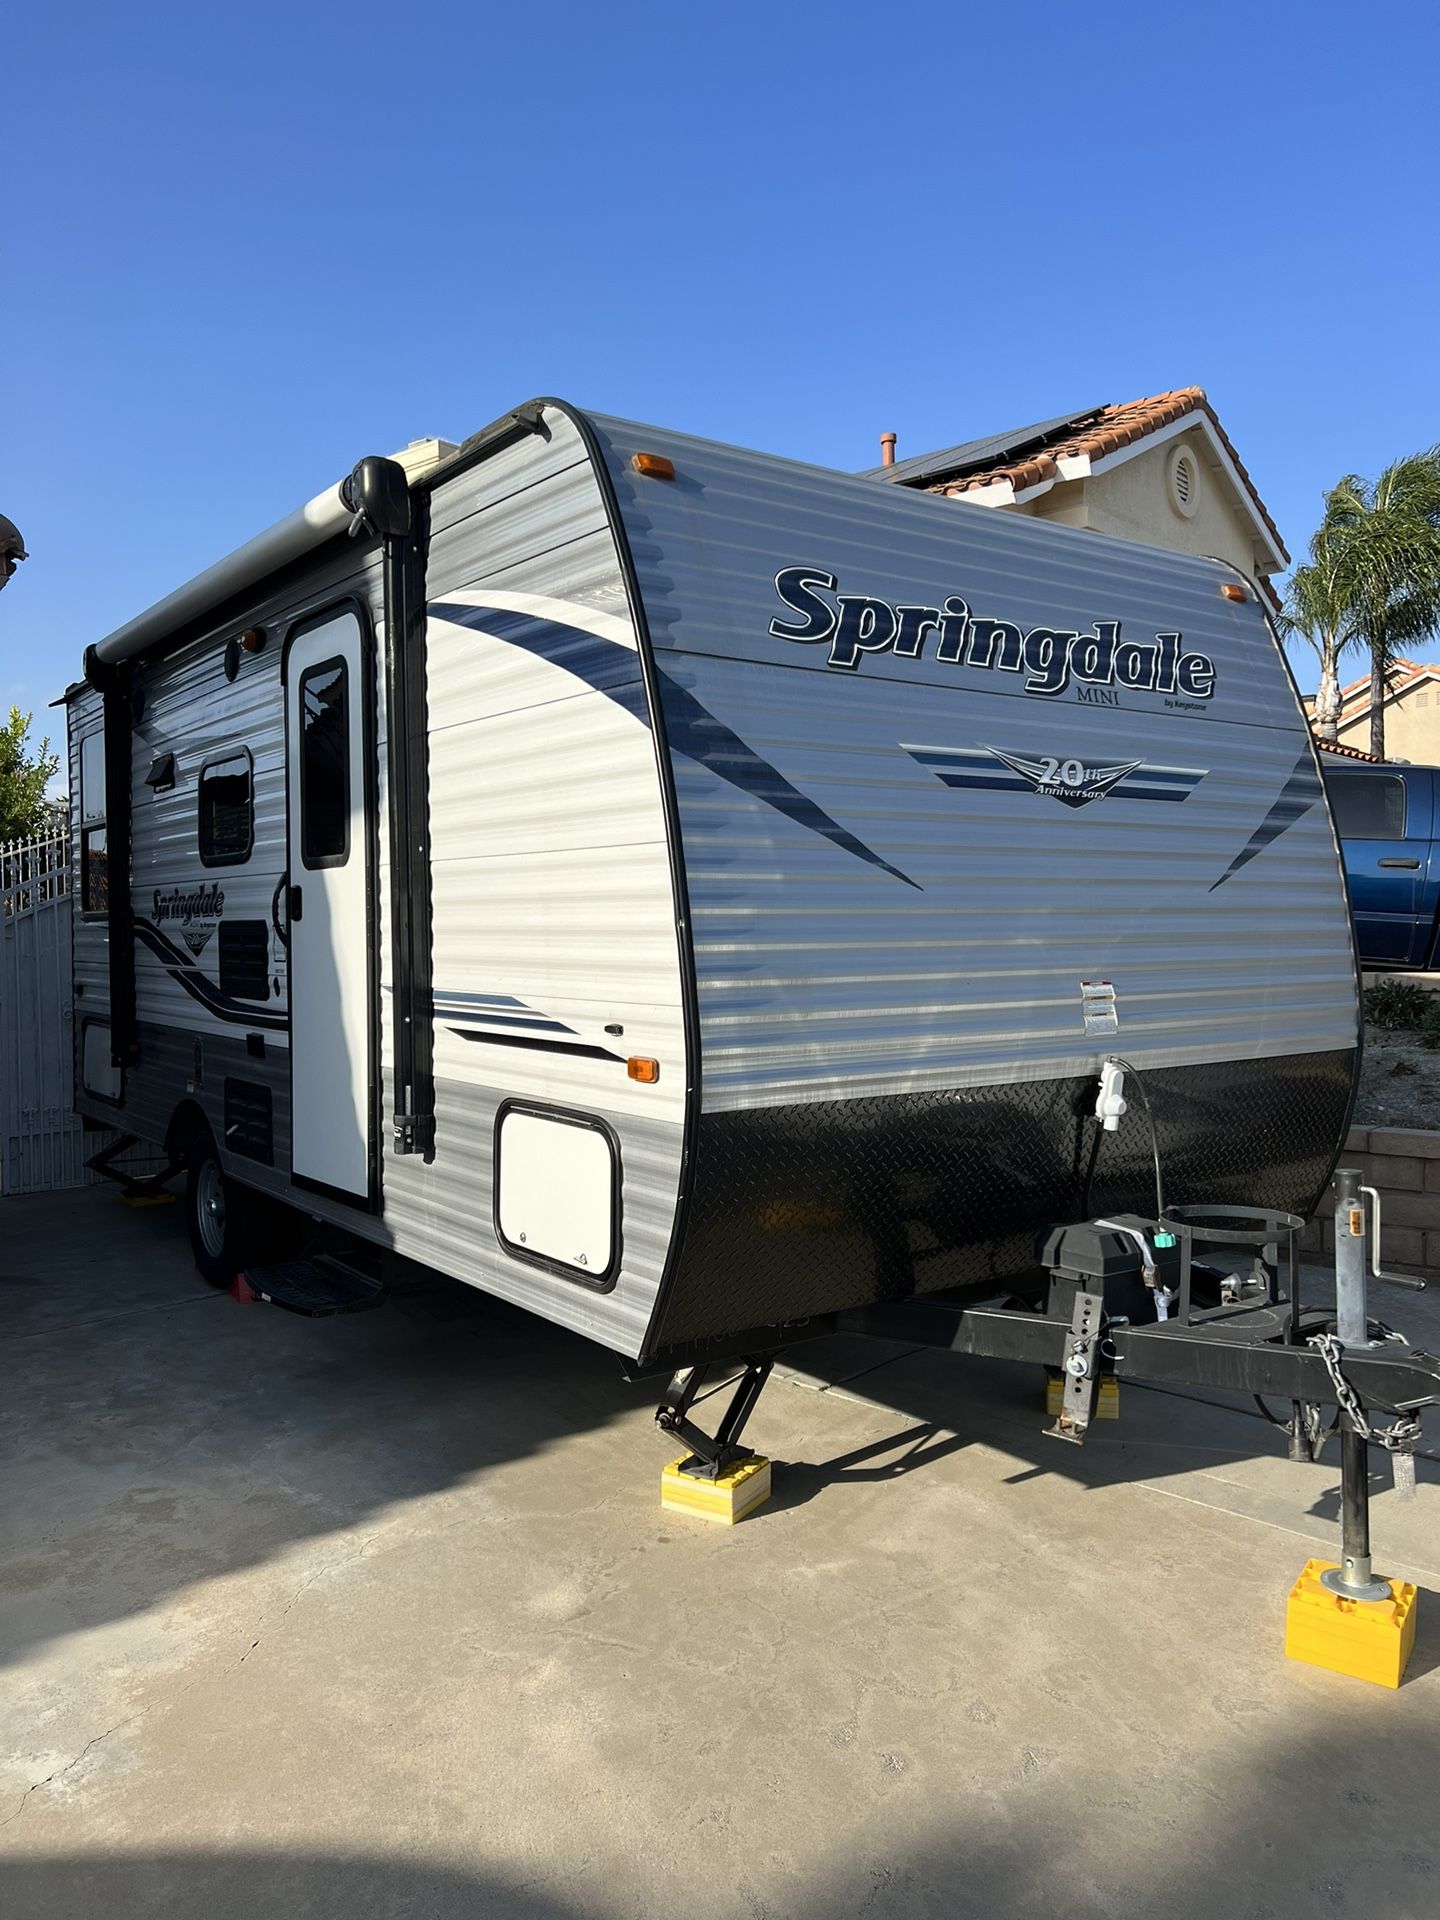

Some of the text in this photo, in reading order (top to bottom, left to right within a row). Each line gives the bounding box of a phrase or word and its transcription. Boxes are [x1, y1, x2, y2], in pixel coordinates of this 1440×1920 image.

[769, 566, 1215, 697] Springdale
[1076, 687, 1120, 705] MINI
[1164, 699, 1174, 708] by
[1034, 784, 1106, 799] Anniversary
[152, 881, 225, 926] Springdale
